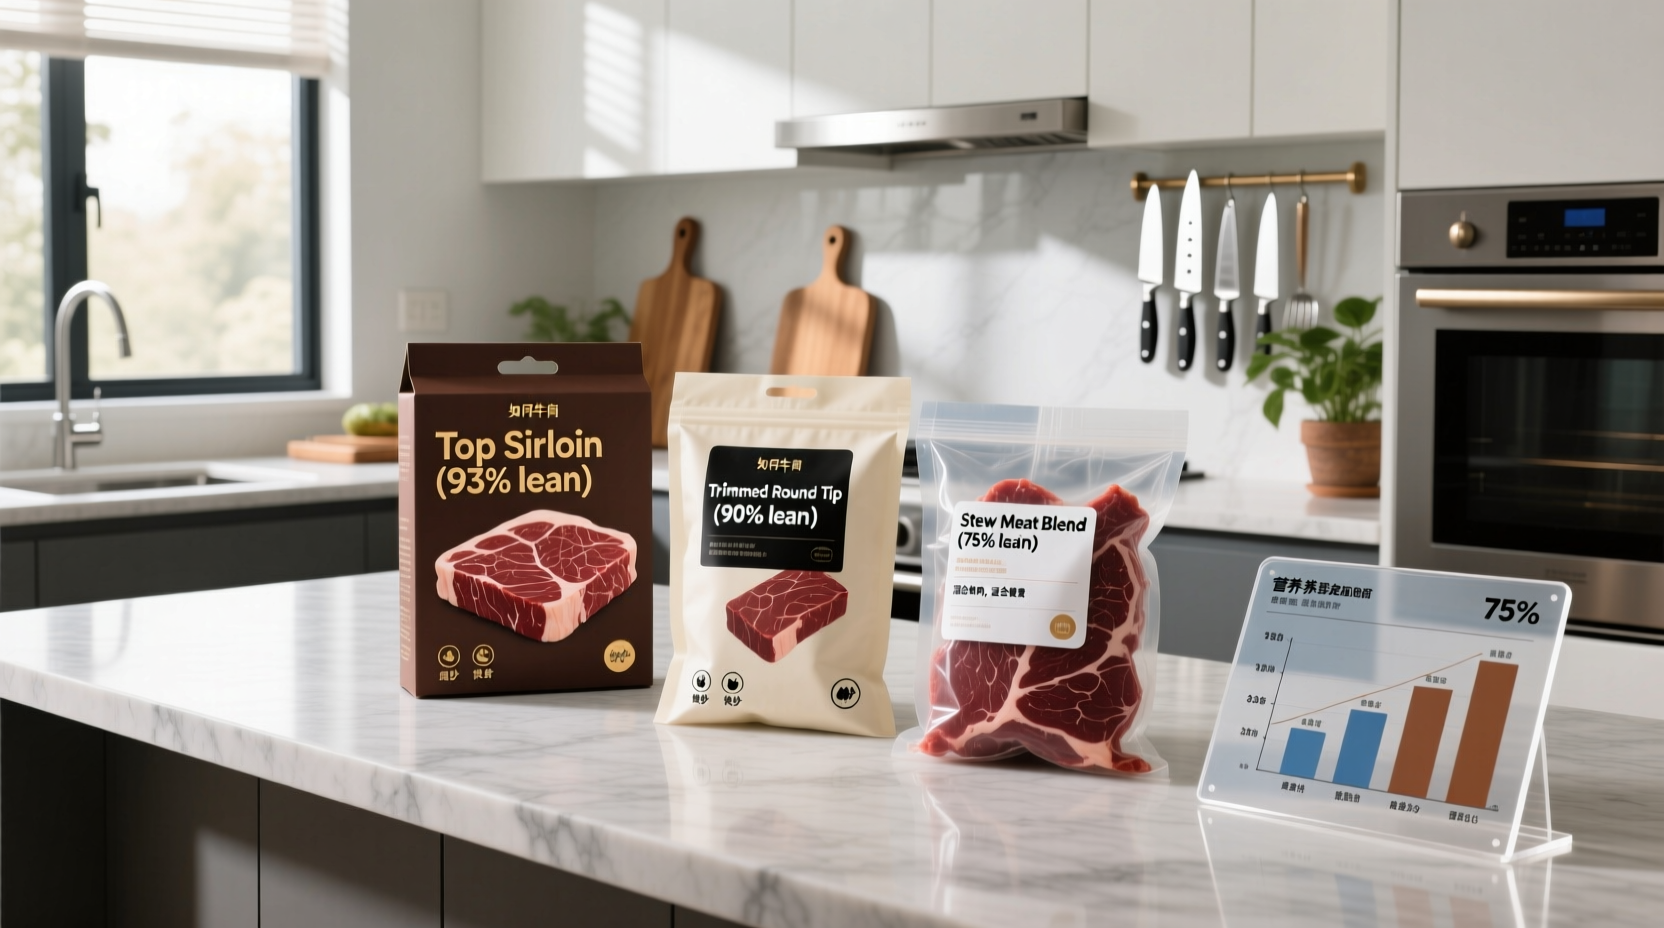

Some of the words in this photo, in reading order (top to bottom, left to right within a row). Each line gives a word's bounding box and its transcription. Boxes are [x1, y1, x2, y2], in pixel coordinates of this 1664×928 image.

[435, 431, 496, 467] Top
[504, 429, 603, 459] Sirloin
[436, 465, 511, 500] (93%
[518, 464, 592, 498] lean)
[708, 482, 769, 499] Trimmed
[772, 485, 818, 499] Round
[821, 485, 843, 505] Tip
[713, 504, 764, 527] (90%
[768, 504, 818, 530] lean)
[960, 512, 998, 529] Stew
[1000, 514, 1039, 530] Meat
[1041, 515, 1088, 532] Blend
[957, 531, 996, 550] (75%
[1484, 597, 1540, 625] 75%
